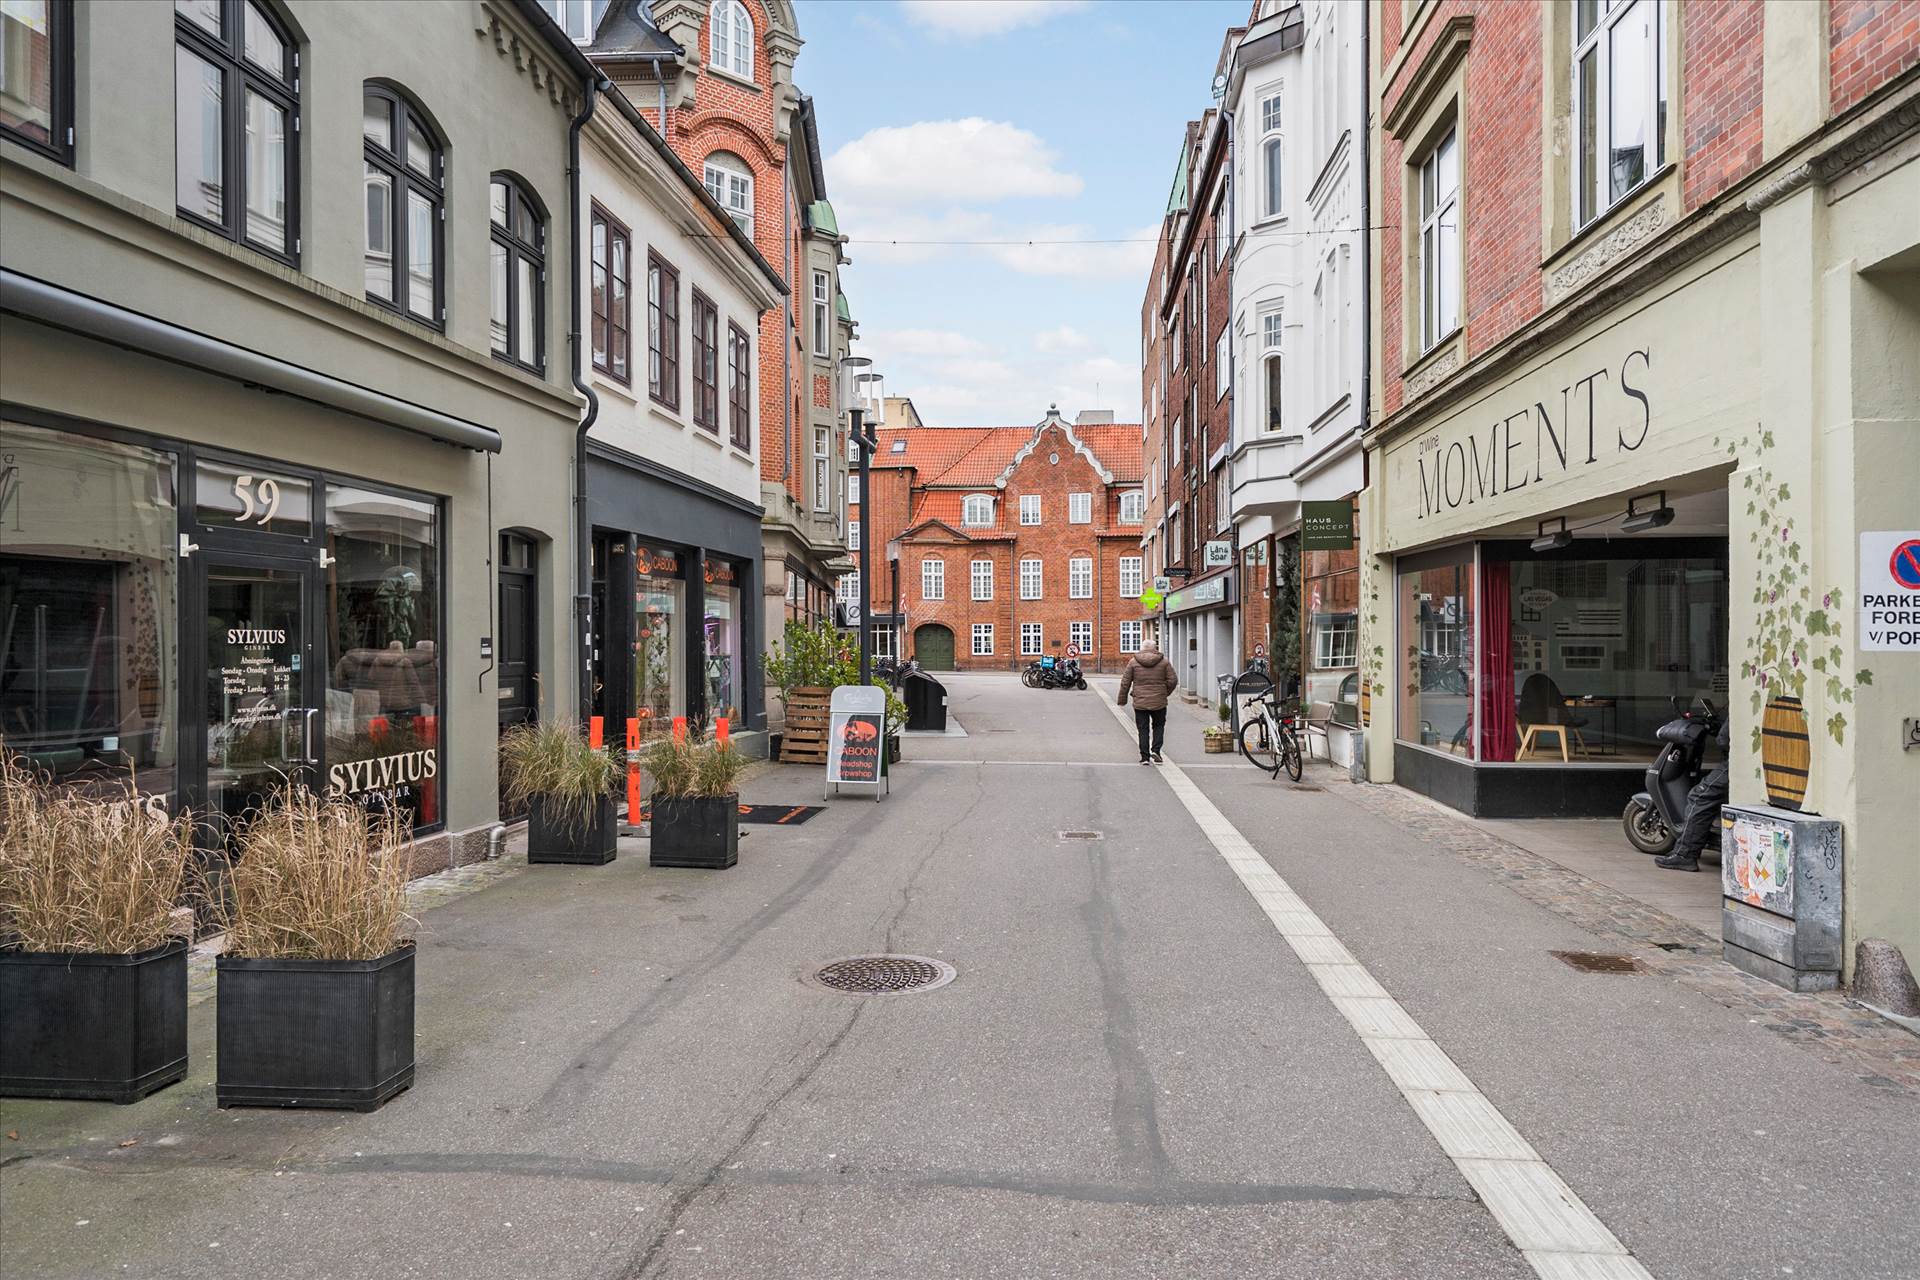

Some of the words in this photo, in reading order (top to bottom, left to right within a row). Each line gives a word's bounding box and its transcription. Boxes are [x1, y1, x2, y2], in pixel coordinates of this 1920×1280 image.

[1418, 346, 1650, 519] MOMENTS
[235, 475, 280, 525] 59
[1863, 594, 1920, 607] PARKE
[228, 629, 286, 643] SYLVIUS
[330, 749, 437, 797] SYLVIUS
